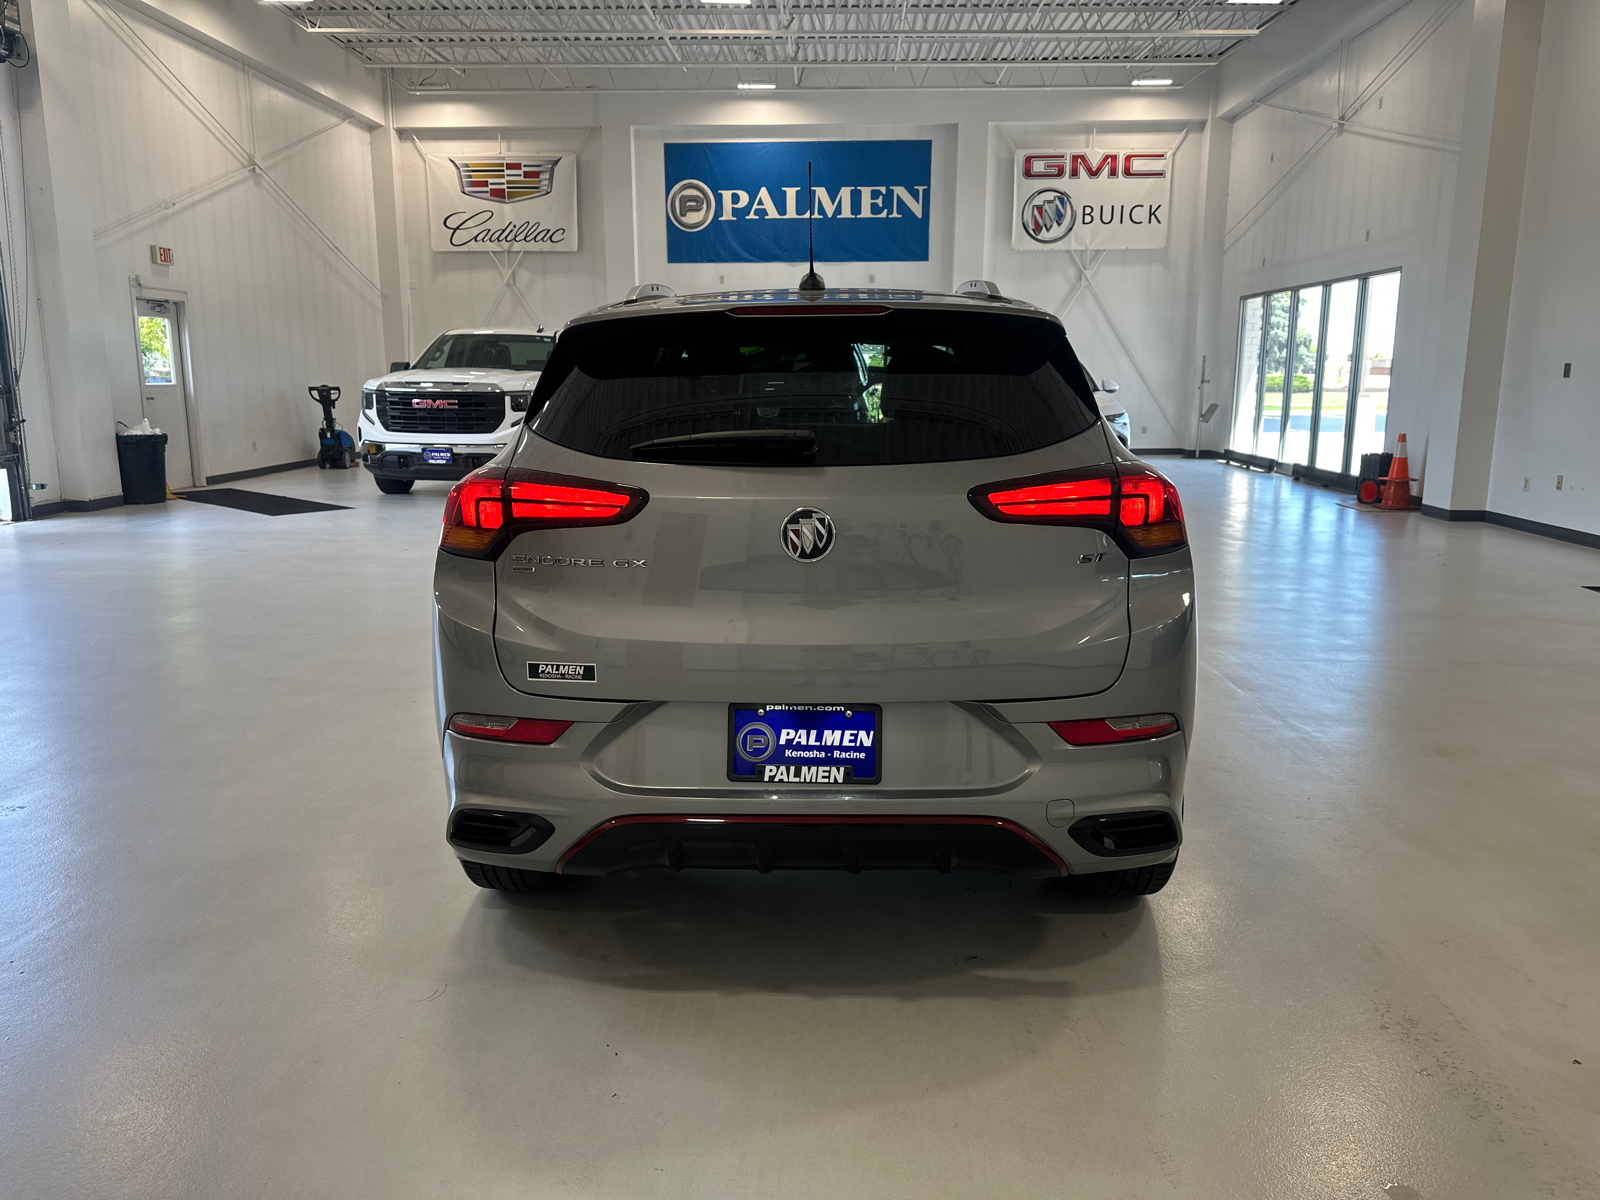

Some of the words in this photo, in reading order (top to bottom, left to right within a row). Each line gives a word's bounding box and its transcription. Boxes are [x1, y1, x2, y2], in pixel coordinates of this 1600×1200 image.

[1022, 152, 1168, 180] GMC
[718, 185, 928, 221] PALMEN
[1082, 204, 1162, 225] BUICK
[443, 209, 566, 247] Cadillac
[159, 246, 172, 264] EXIT
[411, 398, 459, 409] GMC
[512, 555, 605, 567] ENCORE
[612, 559, 649, 568] GX
[538, 664, 585, 675] PALMEN
[766, 703, 845, 712] palmen.com
[778, 728, 875, 747] PALMEN
[785, 749, 826, 758] Kenosha
[833, 750, 866, 759] Racine
[763, 765, 845, 783] PALMEN
